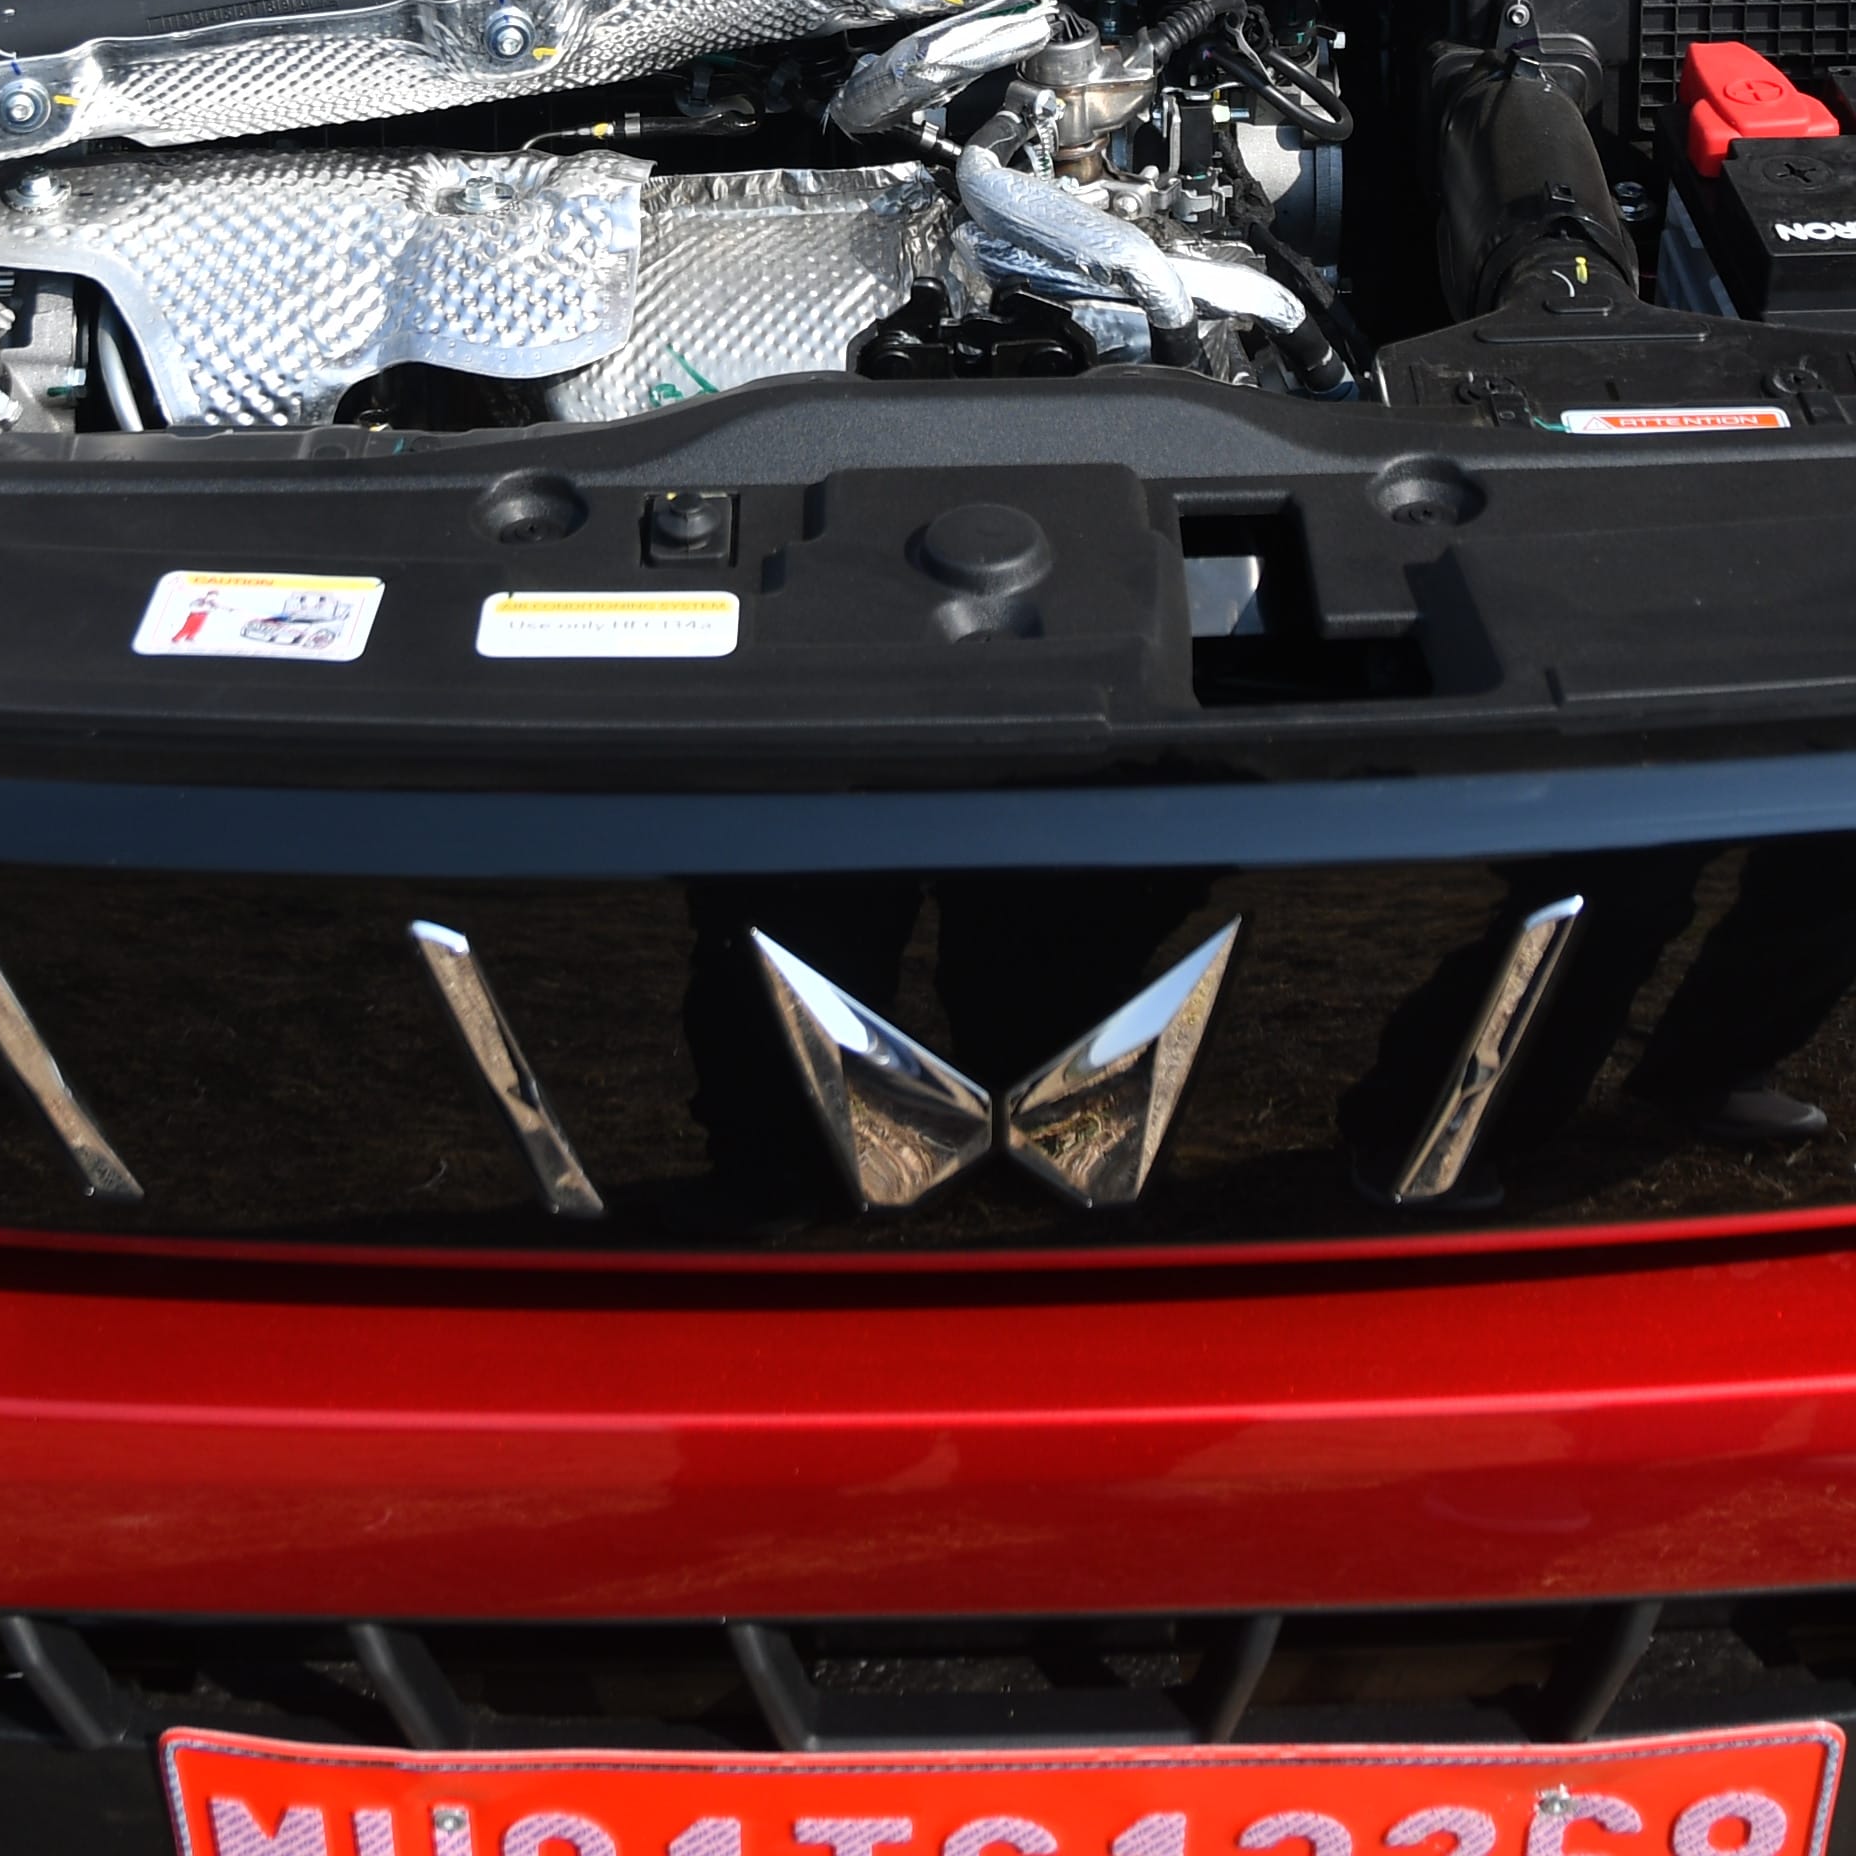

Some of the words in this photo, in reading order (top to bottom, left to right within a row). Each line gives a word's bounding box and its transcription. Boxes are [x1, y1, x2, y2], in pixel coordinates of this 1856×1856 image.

[1620, 415, 1759, 428] ATTENTION
[194, 576, 275, 587] CAUTION
[659, 601, 726, 611] SYSTEM
